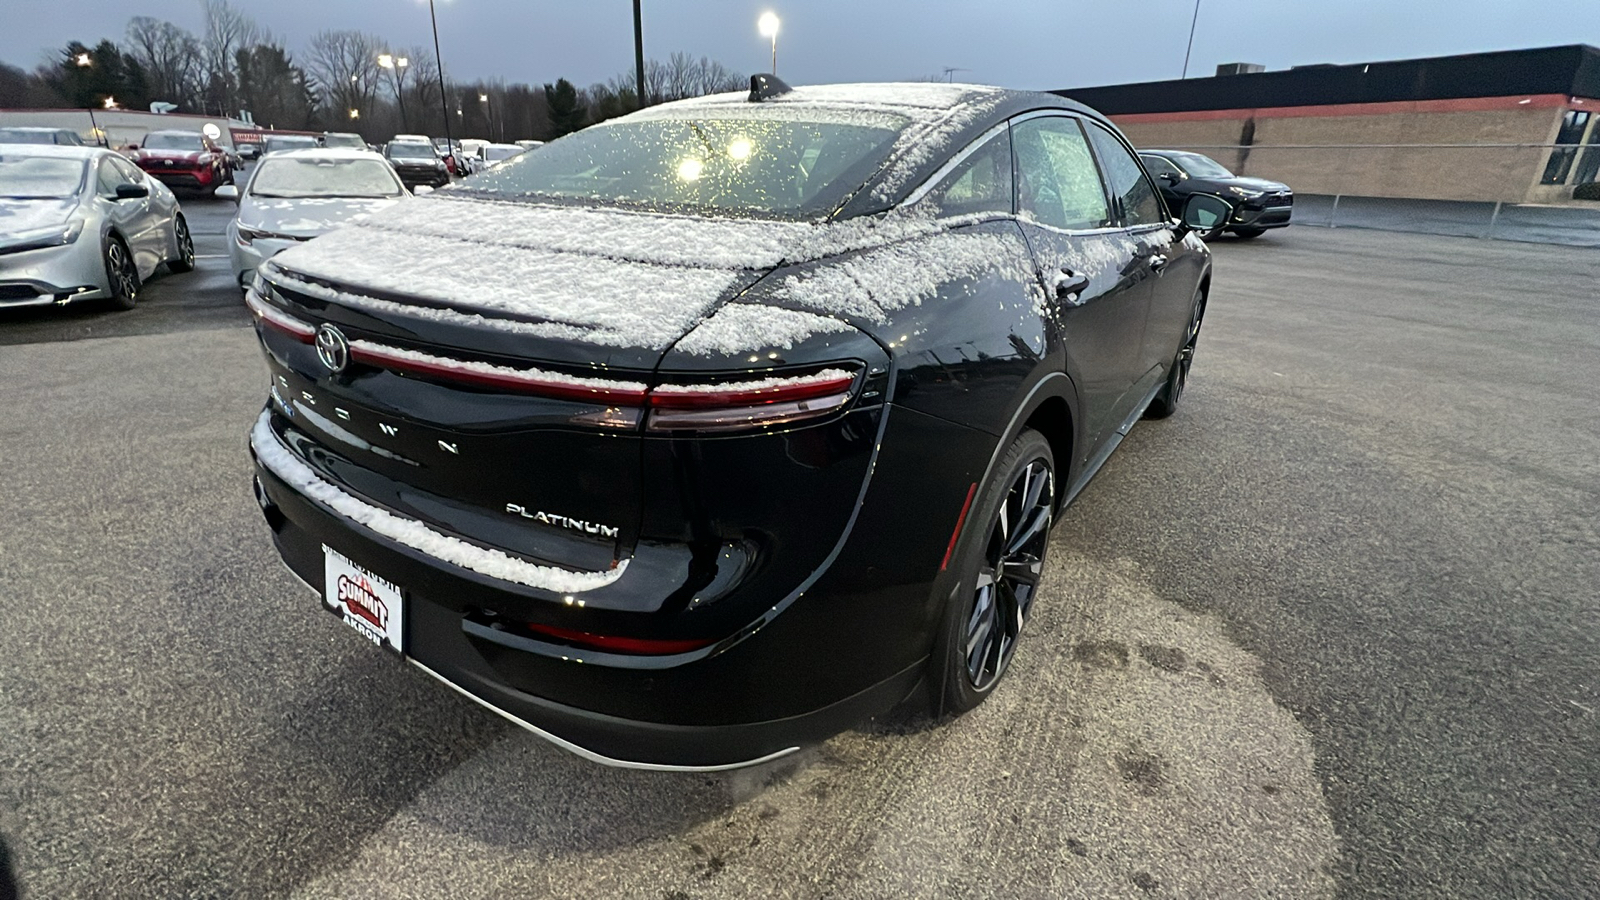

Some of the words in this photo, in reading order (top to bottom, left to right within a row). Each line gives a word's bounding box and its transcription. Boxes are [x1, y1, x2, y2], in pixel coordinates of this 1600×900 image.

[506, 503, 619, 538] PLATINUM
[338, 575, 388, 630] SUMMIT
[343, 615, 381, 646] AKRON
